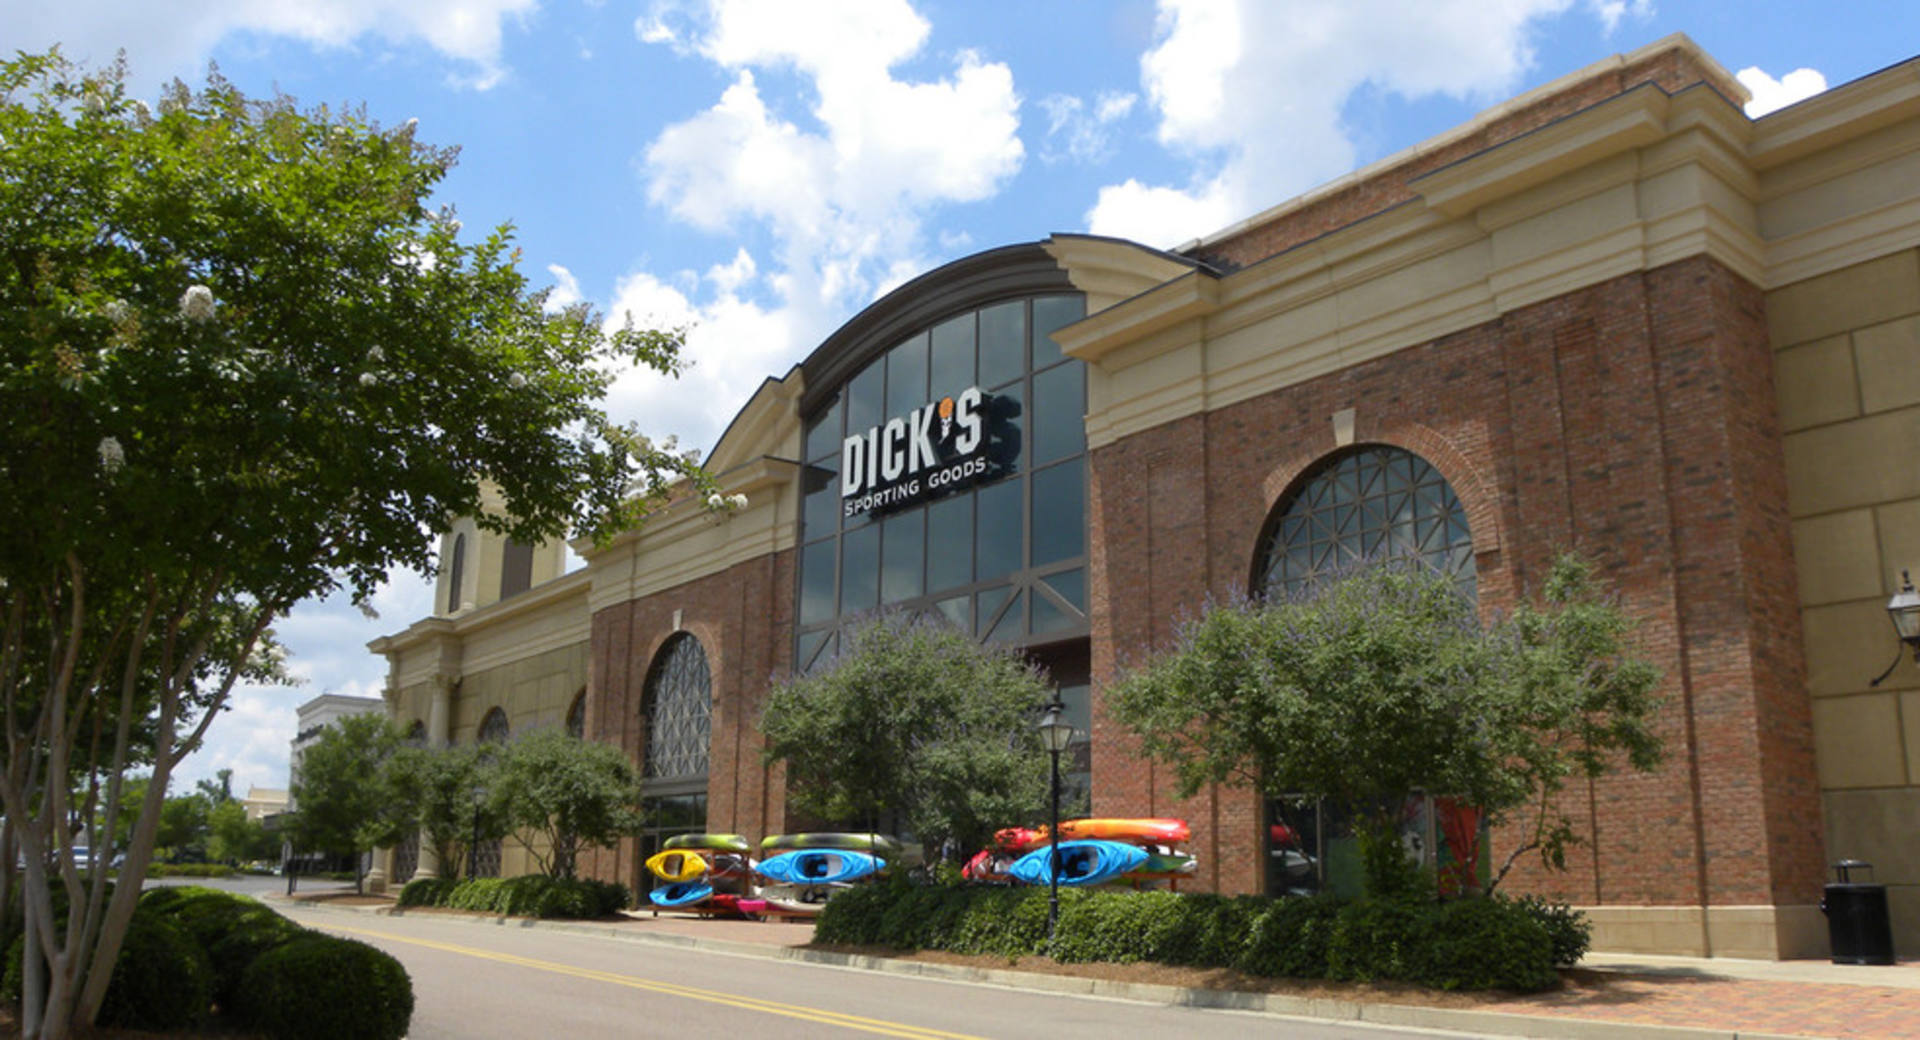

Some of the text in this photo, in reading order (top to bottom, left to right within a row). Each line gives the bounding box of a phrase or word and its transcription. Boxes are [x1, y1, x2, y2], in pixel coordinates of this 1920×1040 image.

[842, 386, 982, 497] DICK'S
[844, 456, 986, 517] SPORTING GOODS
